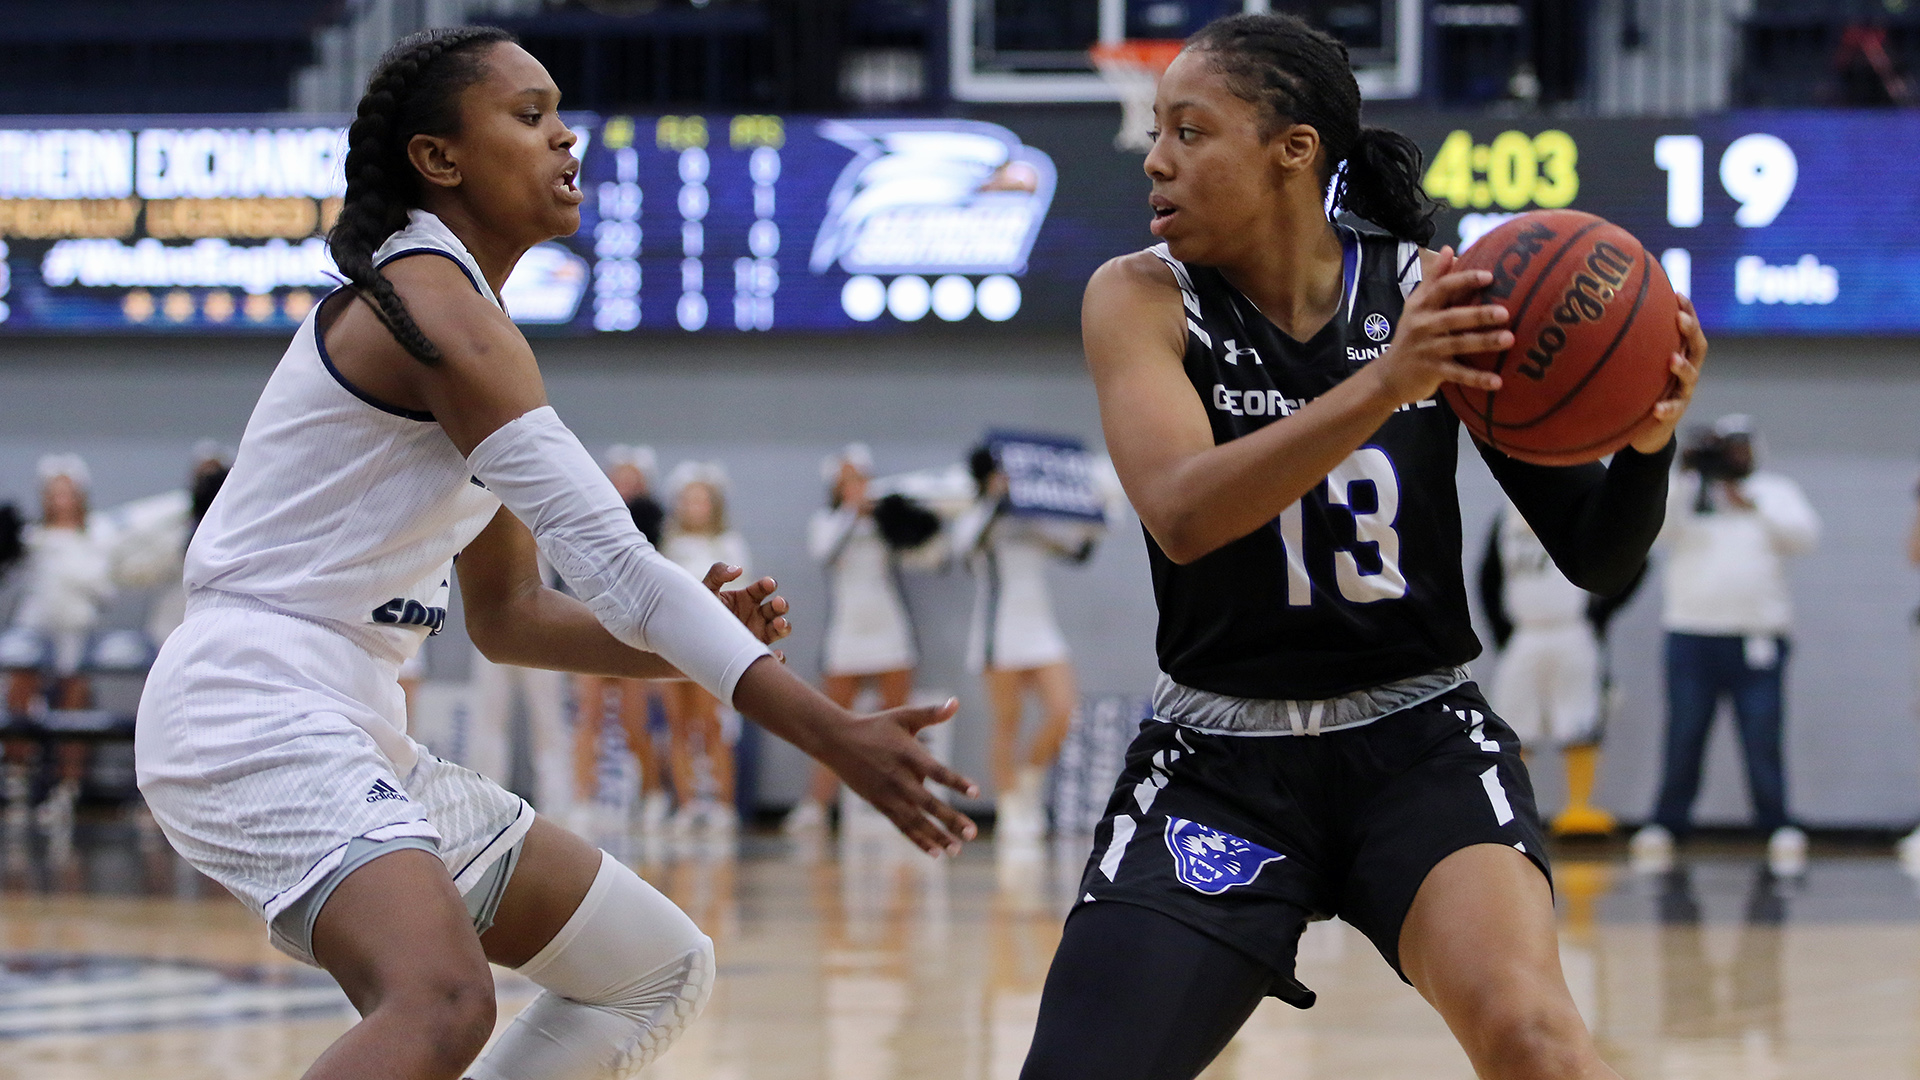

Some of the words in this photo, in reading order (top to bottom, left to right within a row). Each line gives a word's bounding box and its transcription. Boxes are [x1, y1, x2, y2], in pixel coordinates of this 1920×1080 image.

[1423, 130, 1579, 208] 4:03
[1654, 133, 1798, 228] 19
[1517, 240, 1635, 382] Wilson
[1735, 254, 1839, 304] Fouls
[1346, 346, 1379, 361] SUN
[1279, 444, 1410, 606] 13
